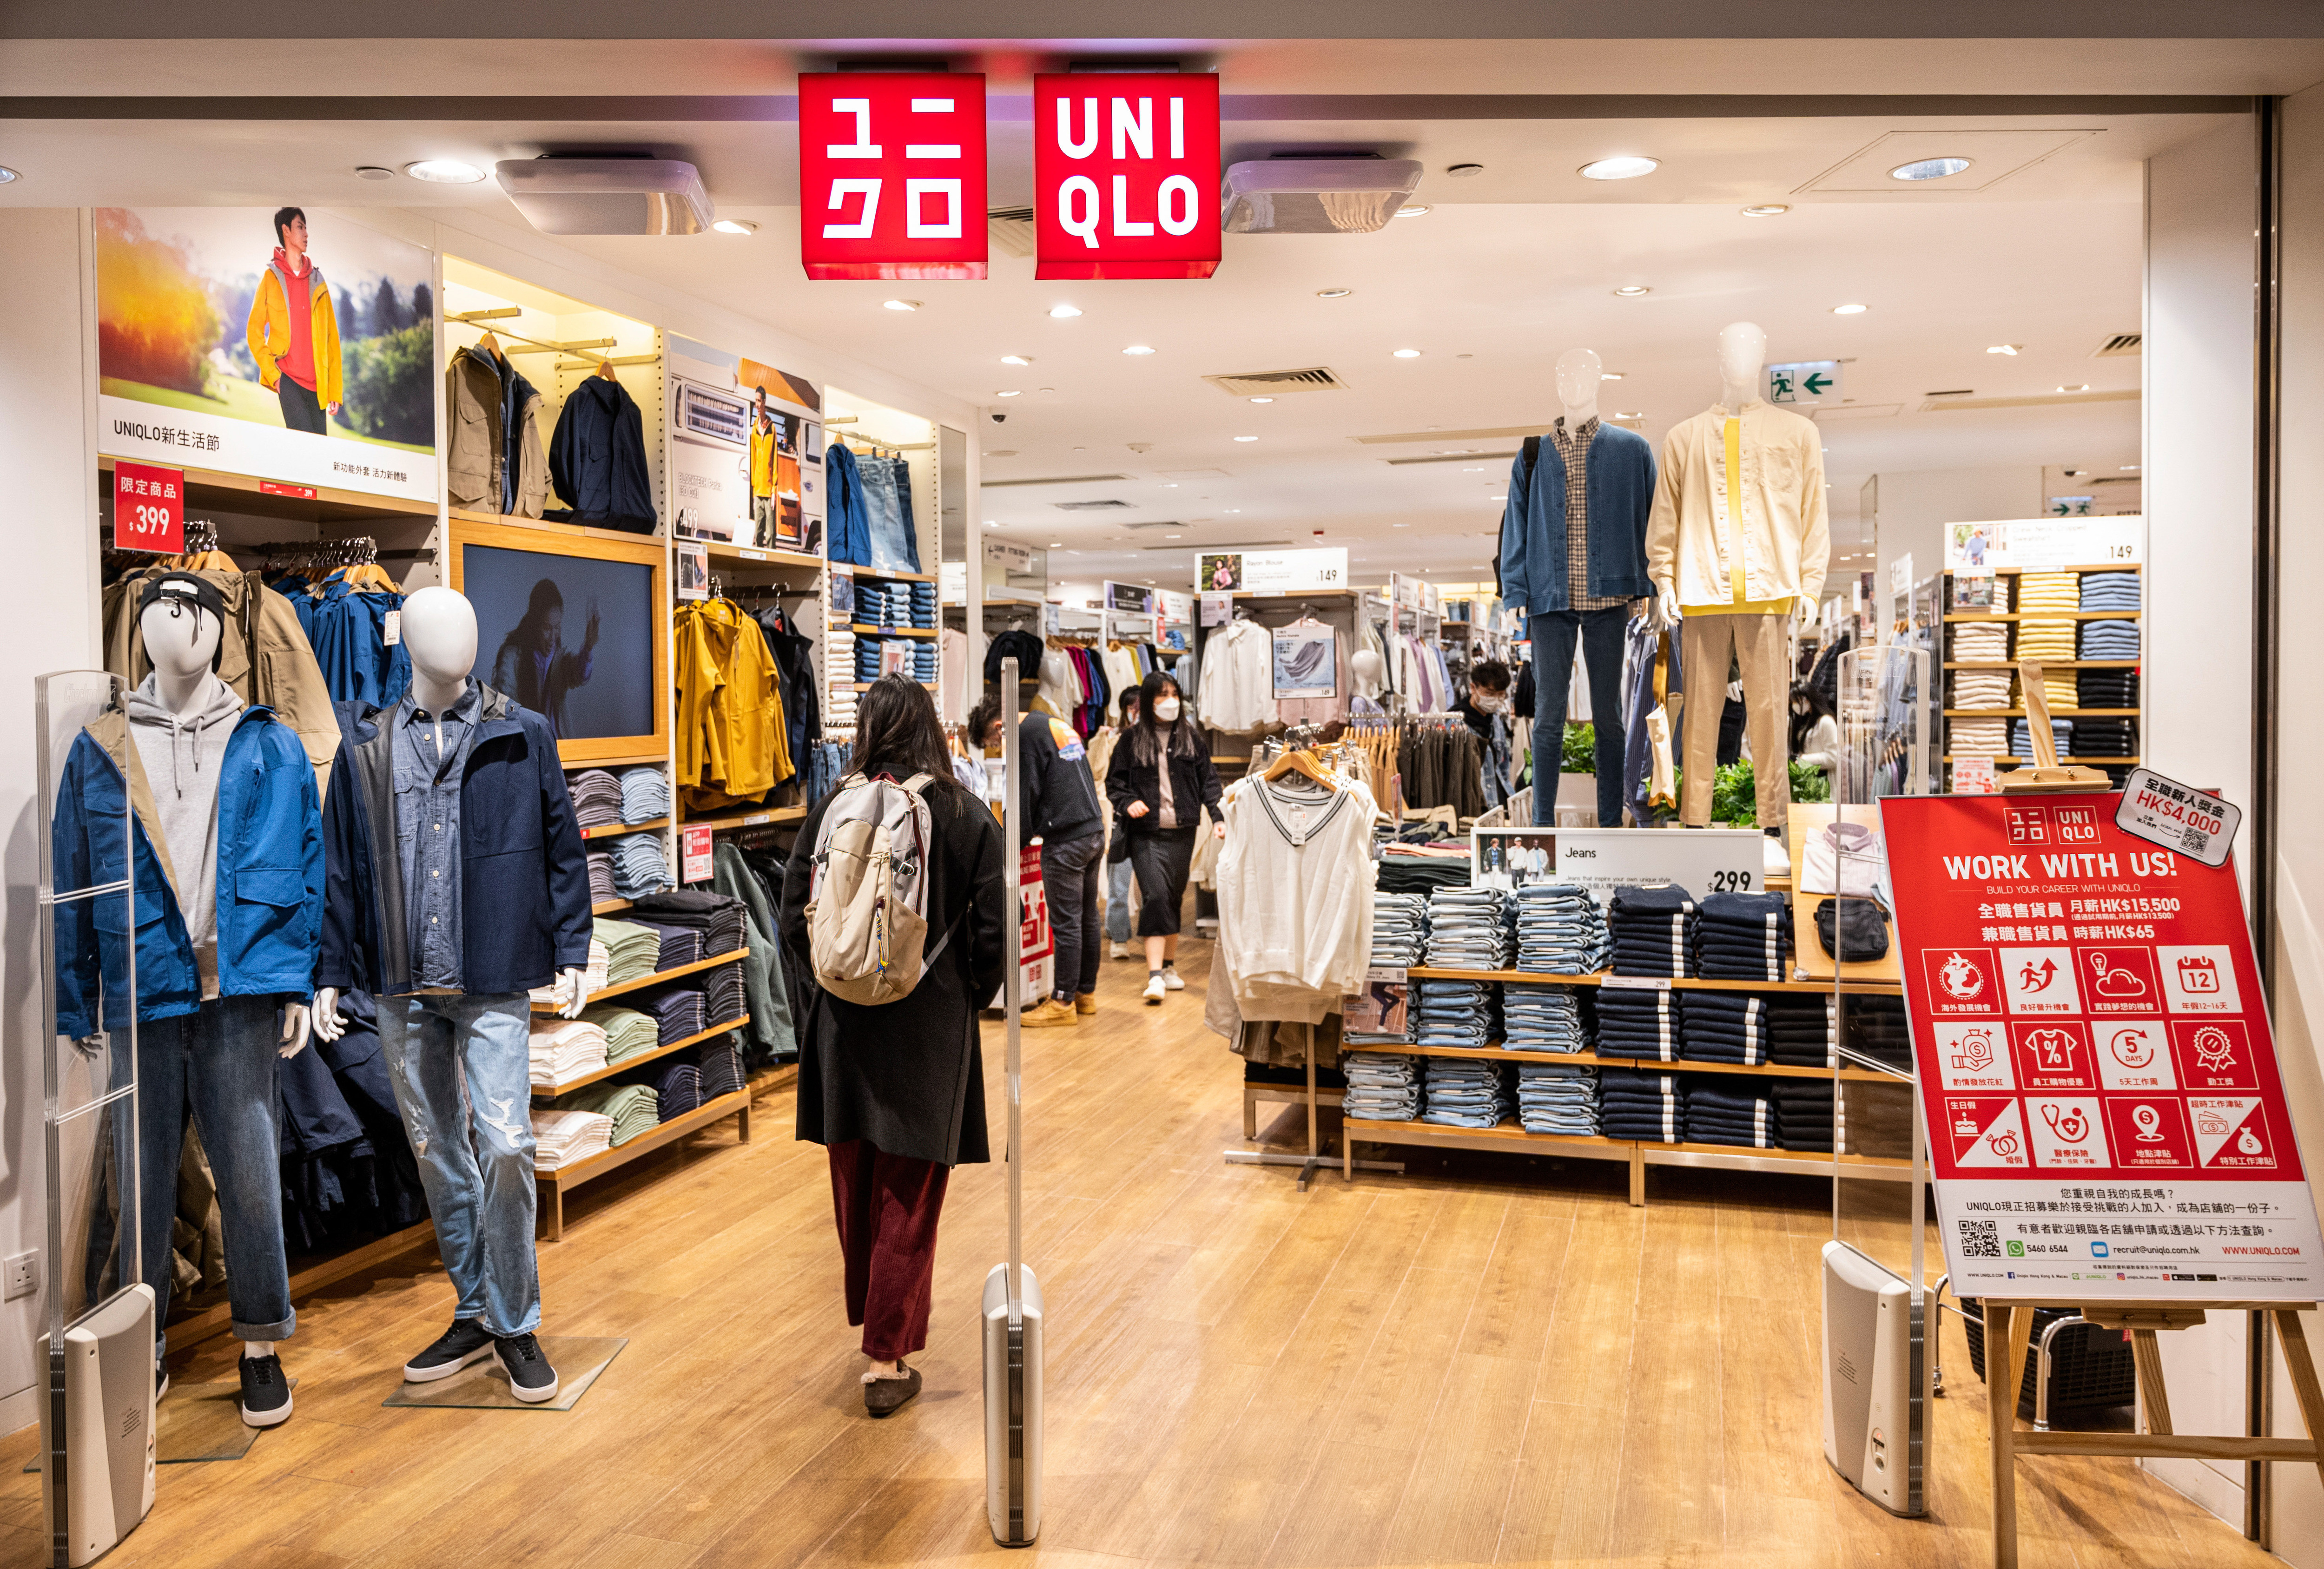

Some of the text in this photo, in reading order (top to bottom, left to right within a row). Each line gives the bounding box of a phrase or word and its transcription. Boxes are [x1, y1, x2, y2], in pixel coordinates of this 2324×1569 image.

[1056, 97, 1184, 159] UNI
[1058, 174, 1199, 248] QLO
[114, 420, 220, 452] UNIQLO新生活節
[120, 477, 177, 499] 限定商品
[679, 472, 707, 488] BLOCKTECH
[129, 505, 170, 535] $399
[2145, 778, 2225, 818] 全職新人獎金
[2060, 811, 2089, 824] UNI
[2137, 790, 2221, 835] HK$4,000
[2062, 826, 2094, 841] QLO
[1565, 847, 1596, 858] Jeans
[1942, 852, 2177, 880] WORK WITH US!
[1708, 870, 1751, 892] $299
[1987, 886, 2013, 894] BUILD
[2042, 884, 2078, 893] CAREER
[2107, 883, 2140, 893] UNIQLO
[1978, 898, 2180, 919] 全職售貨員 月薪HK$15,500
[1981, 925, 2155, 942] 兼職售貨員 時薪HK$65
[2189, 972, 2210, 988] 12
[2094, 1002, 2154, 1011] 實踐夢想的機會
[2125, 1036, 2138, 1053] 5
[2033, 1078, 2084, 1086] 員工購物優惠
[2135, 1149, 2172, 1158] 地點津貼
[2219, 1157, 2274, 1166] 特別工作津貼
[2113, 1246, 2200, 1255] recruit@uniqlo.com.hk
[2222, 1247, 2300, 1255] WWW.UNIQLO.COM
